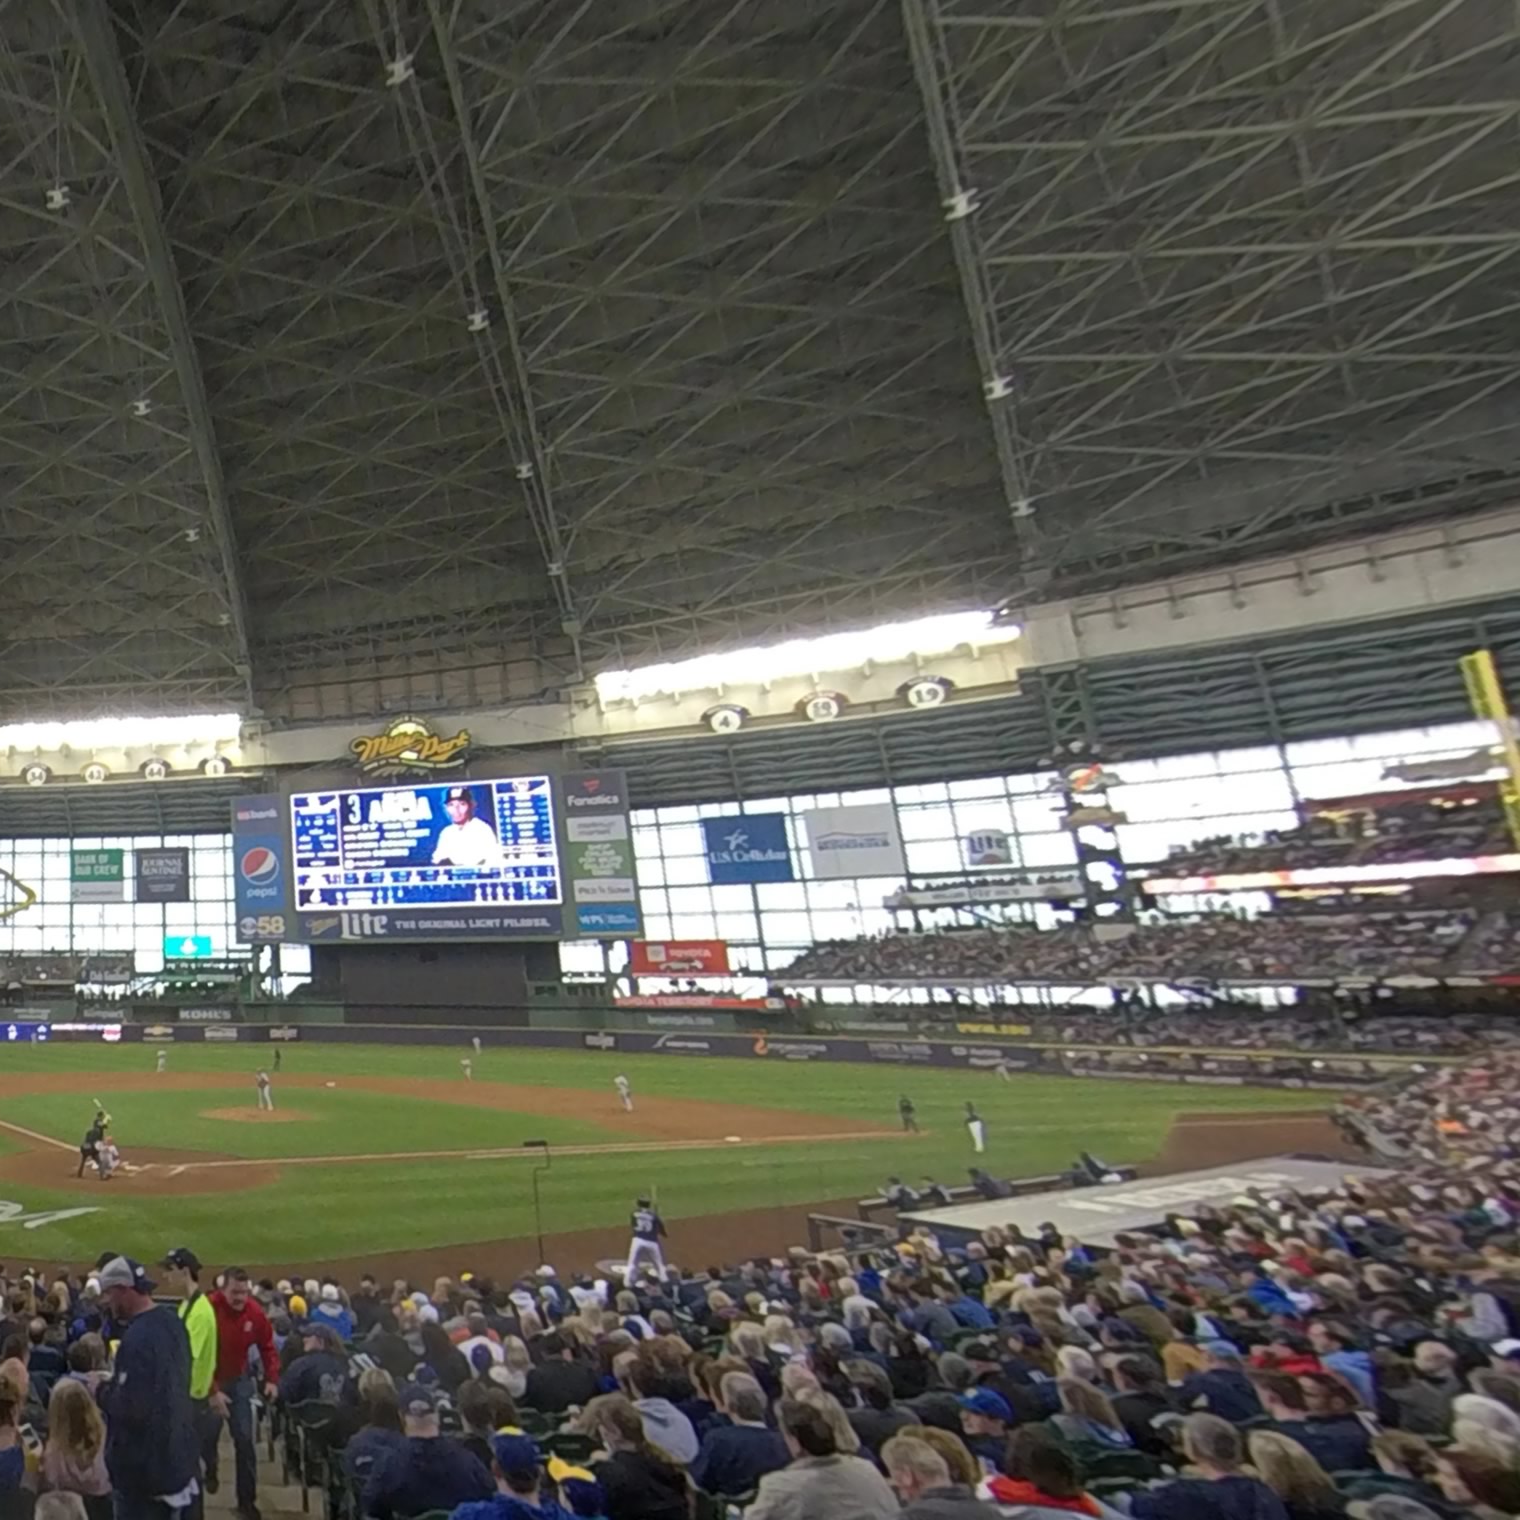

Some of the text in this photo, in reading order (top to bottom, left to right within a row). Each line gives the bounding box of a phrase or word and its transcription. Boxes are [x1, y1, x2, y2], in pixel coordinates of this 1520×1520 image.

[351, 729, 470, 763] Miller Park
[348, 794, 361, 824] 3
[567, 794, 619, 807] Fanatics
[733, 849, 787, 863] Cellular
[246, 887, 278, 899] pepsi
[257, 915, 286, 936] 58
[340, 912, 389, 940] Lite
